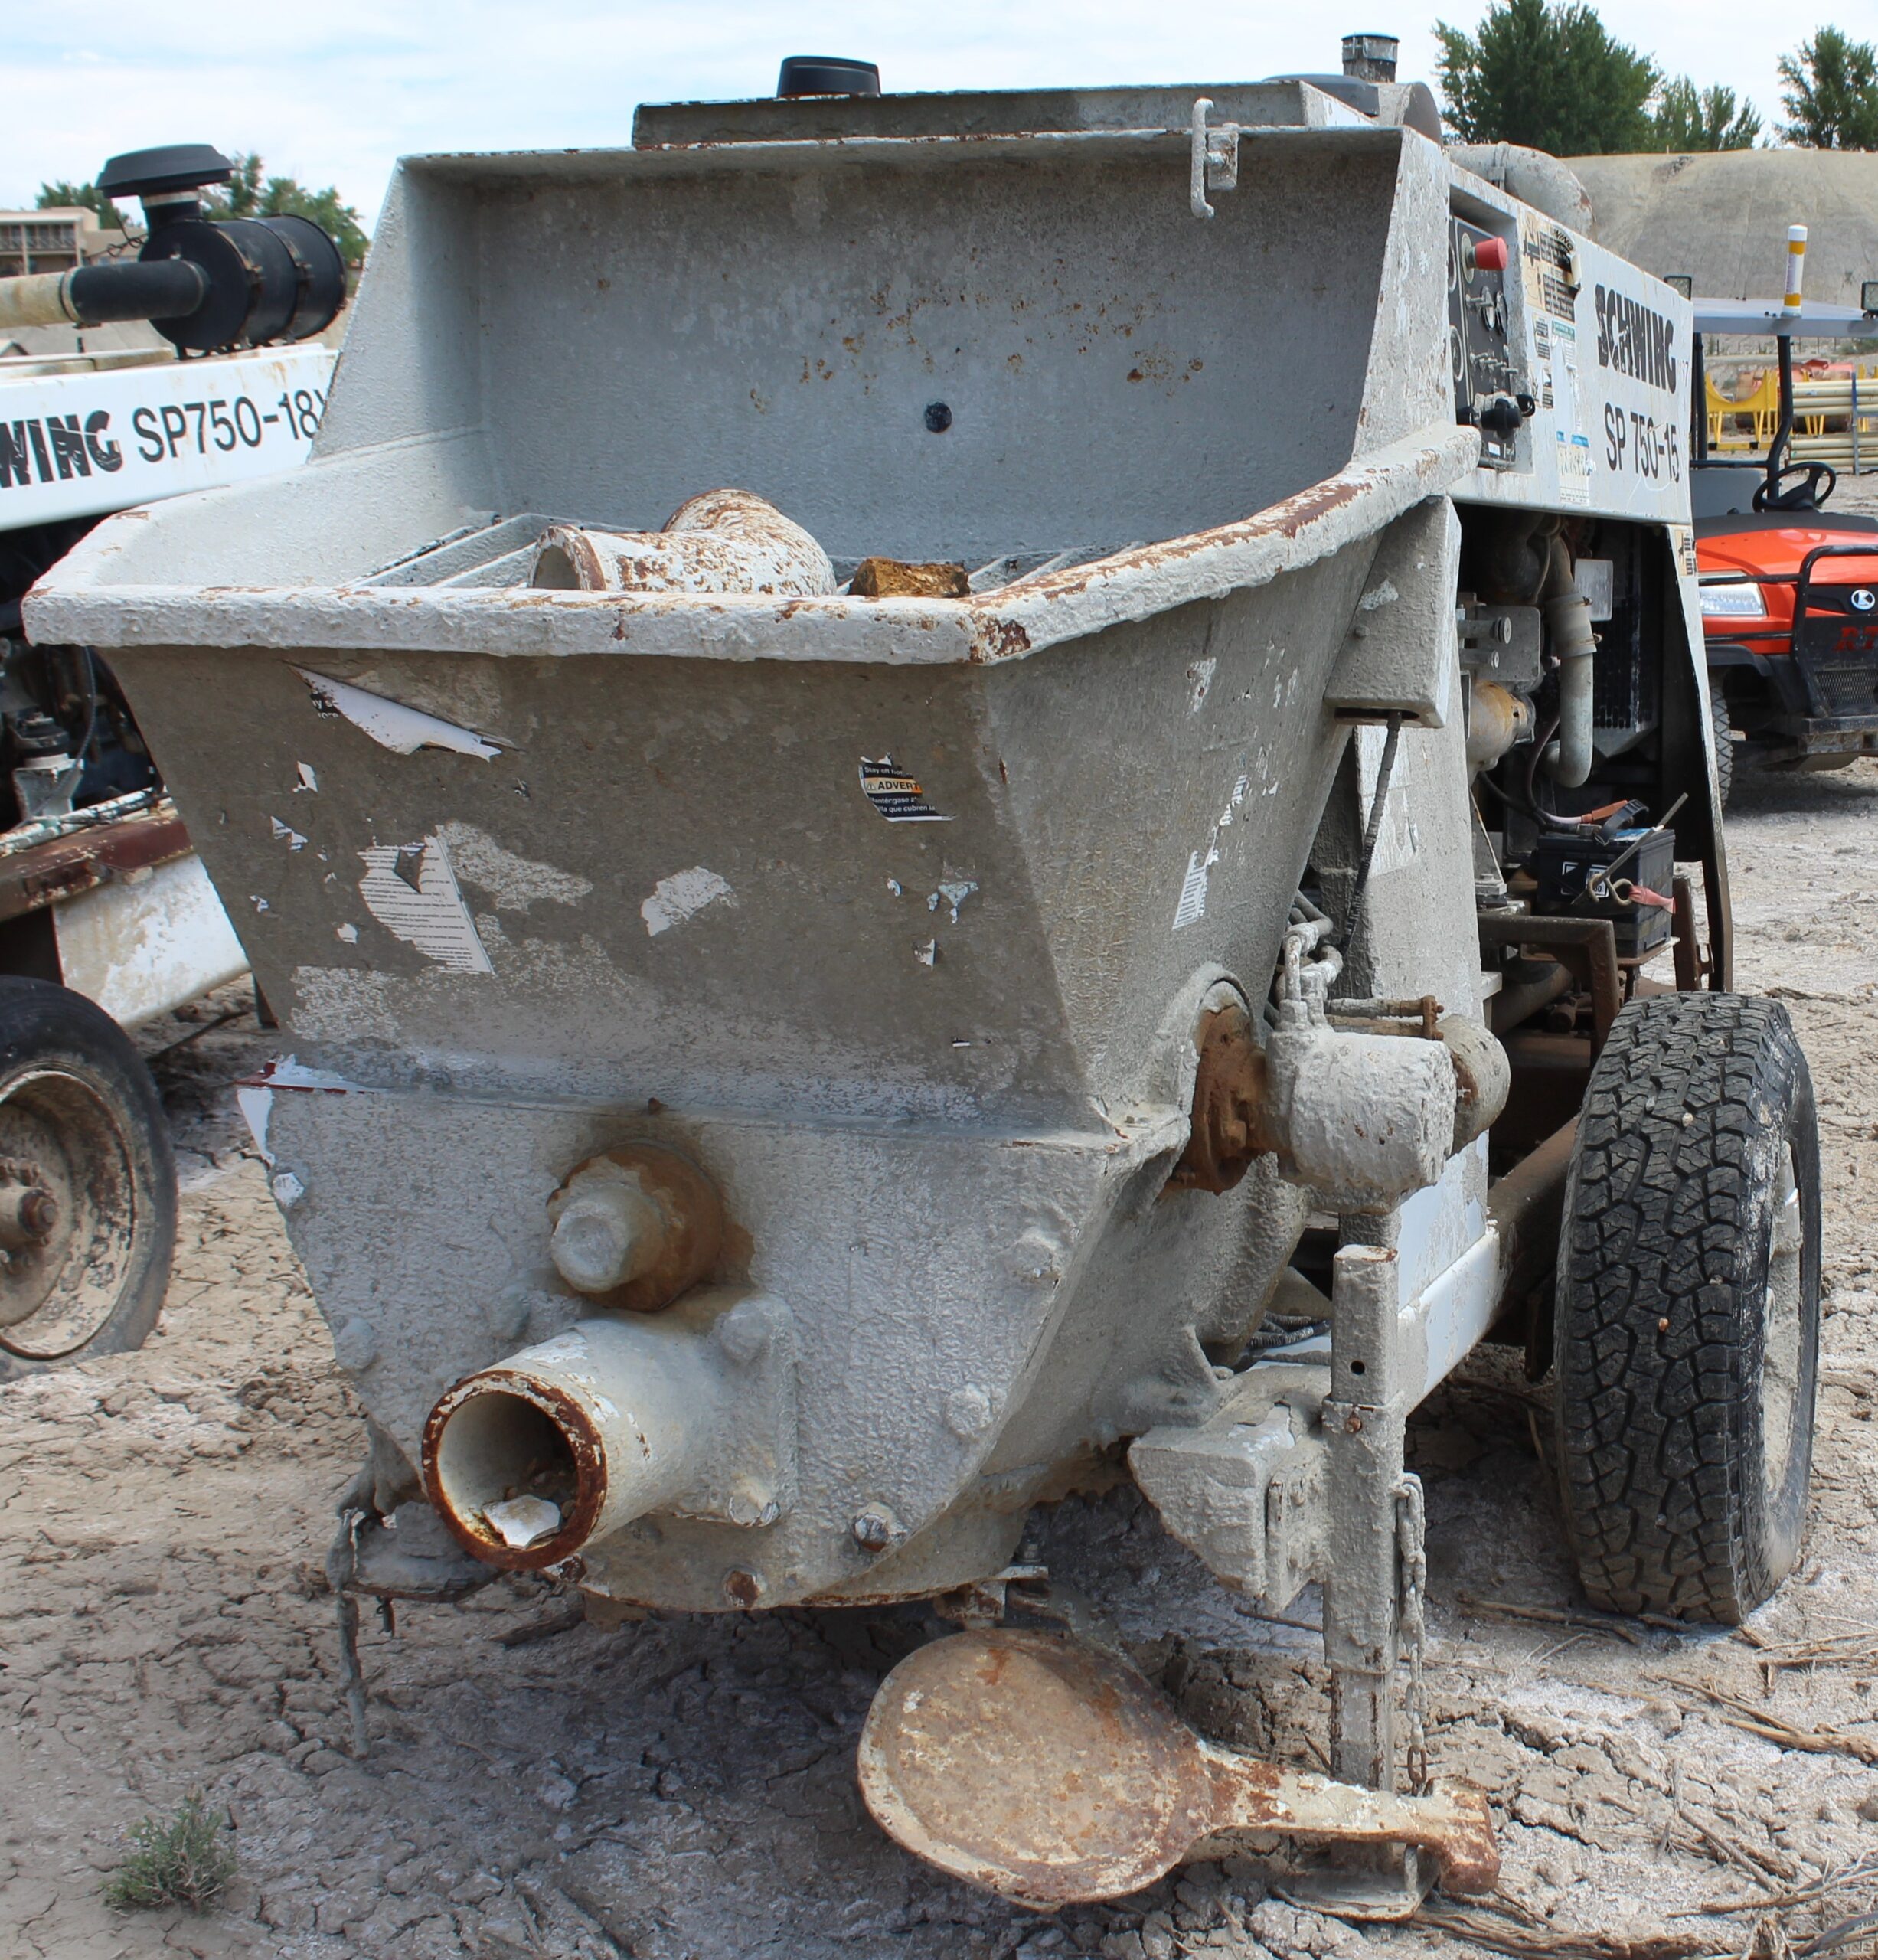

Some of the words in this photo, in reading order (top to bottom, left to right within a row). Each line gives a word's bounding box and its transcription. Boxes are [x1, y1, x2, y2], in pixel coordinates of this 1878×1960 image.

[1595, 283, 1677, 394] SCHWING
[132, 388, 327, 462] SP750-18
[1605, 401, 1626, 472] SP
[1631, 411, 1680, 483] 750-15
